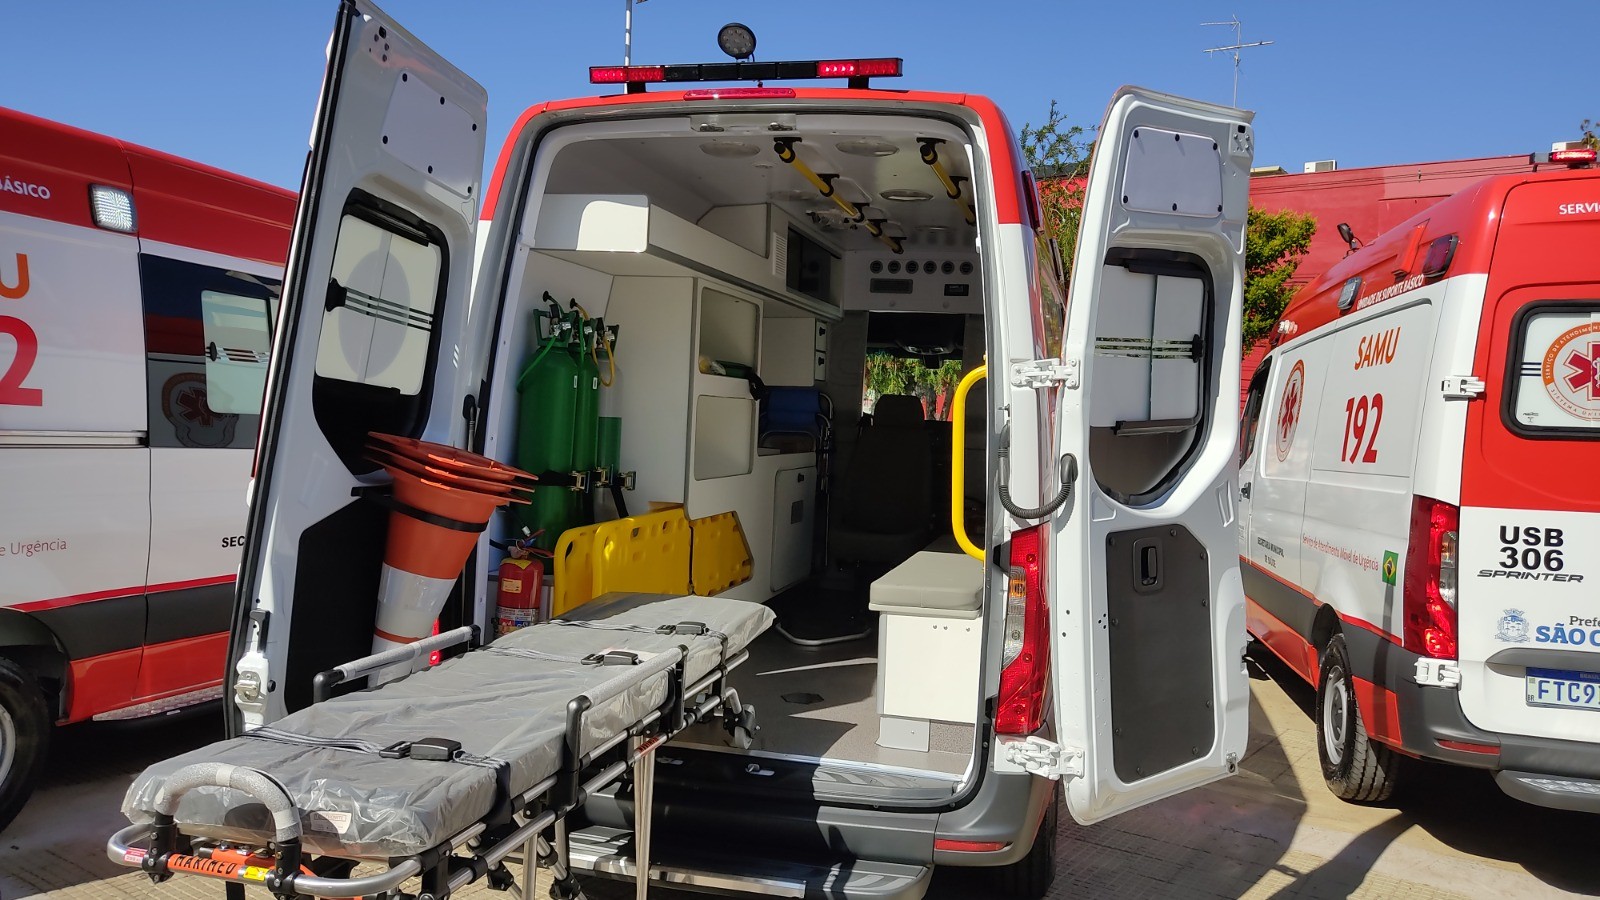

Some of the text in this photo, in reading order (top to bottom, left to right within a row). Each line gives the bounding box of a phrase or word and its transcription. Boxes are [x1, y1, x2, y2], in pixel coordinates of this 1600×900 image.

[0, 175, 51, 200] ÁSICO
[1559, 202, 1600, 215] SERVI
[1354, 326, 1401, 371] SAMU
[1545, 353, 1554, 380] SERVIÇO
[1553, 344, 1560, 353] DE
[1550, 388, 1577, 413] SISTEMA
[1341, 393, 1384, 464] 192
[11, 538, 67, 557] Urgência
[221, 535, 246, 548] SEC
[1499, 525, 1564, 547] USB
[1353, 550, 1359, 565] de
[1359, 553, 1379, 571] Urgência
[1499, 546, 1564, 572] 306
[1477, 569, 1585, 583] SPRINTER
[1535, 622, 1586, 646] SÃO
[1538, 679, 1600, 705] FTC9
